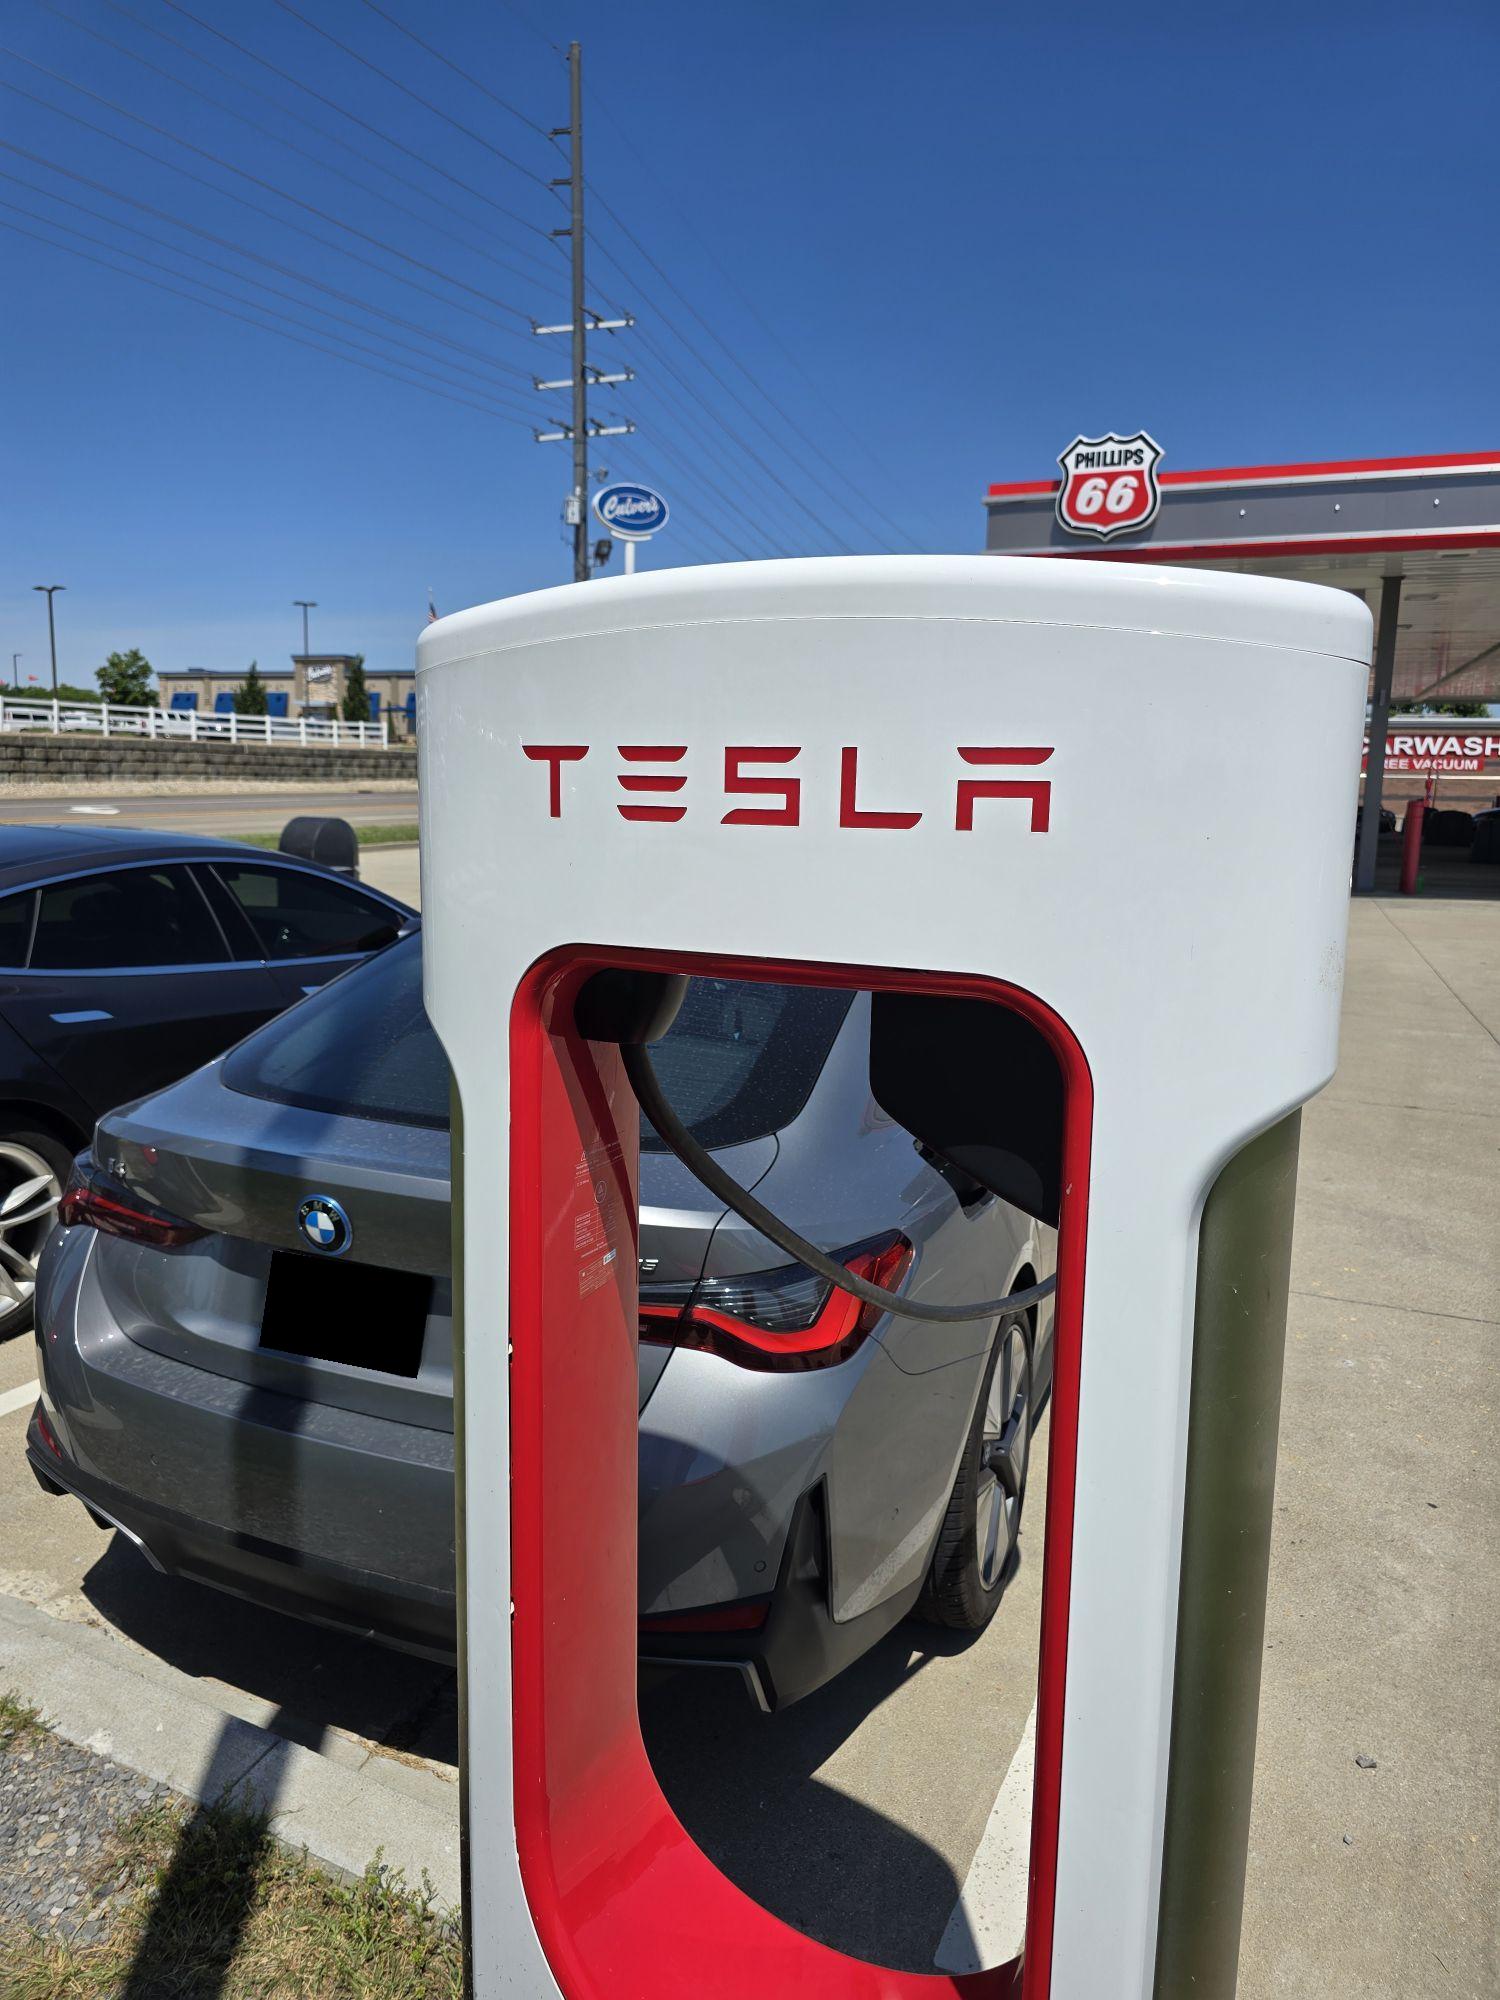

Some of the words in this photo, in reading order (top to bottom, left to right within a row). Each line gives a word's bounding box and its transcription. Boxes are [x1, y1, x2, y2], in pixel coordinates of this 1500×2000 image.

[1074, 448, 1145, 470] PHILLIPS
[1075, 475, 1140, 516] 66
[1412, 758, 1479, 771] VACUUM
[521, 744, 1056, 833] TESLA
